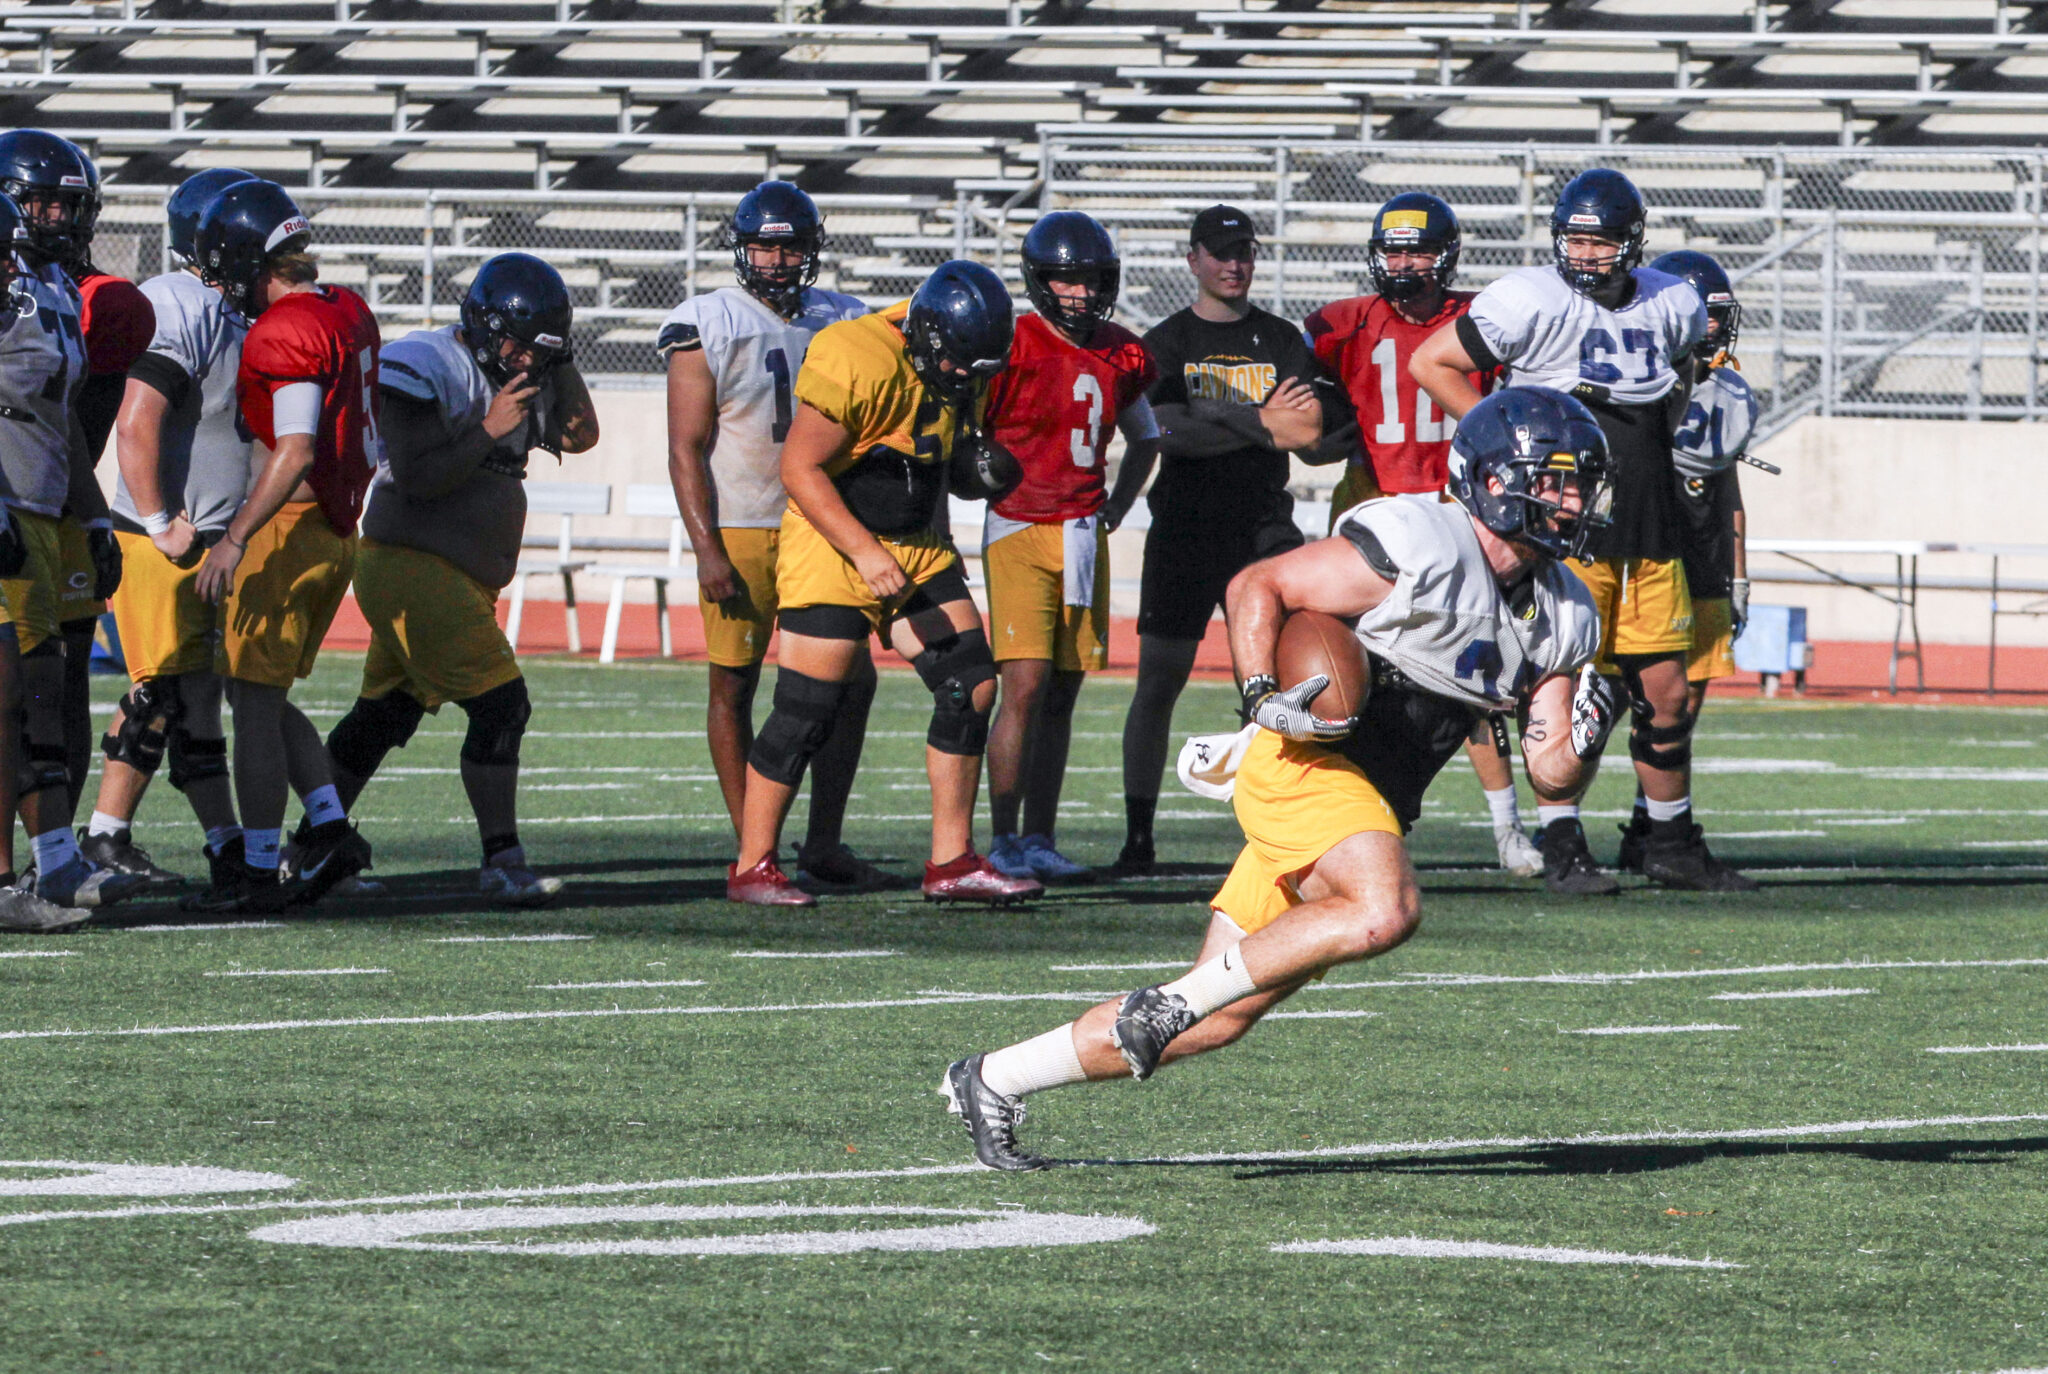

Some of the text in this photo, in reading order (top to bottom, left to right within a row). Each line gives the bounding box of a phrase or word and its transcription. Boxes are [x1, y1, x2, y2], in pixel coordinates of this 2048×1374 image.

[1184, 363, 1277, 405] CANYONS
[1579, 328, 1658, 384] 67
[765, 348, 807, 443] 1
[1070, 373, 1103, 467] 3
